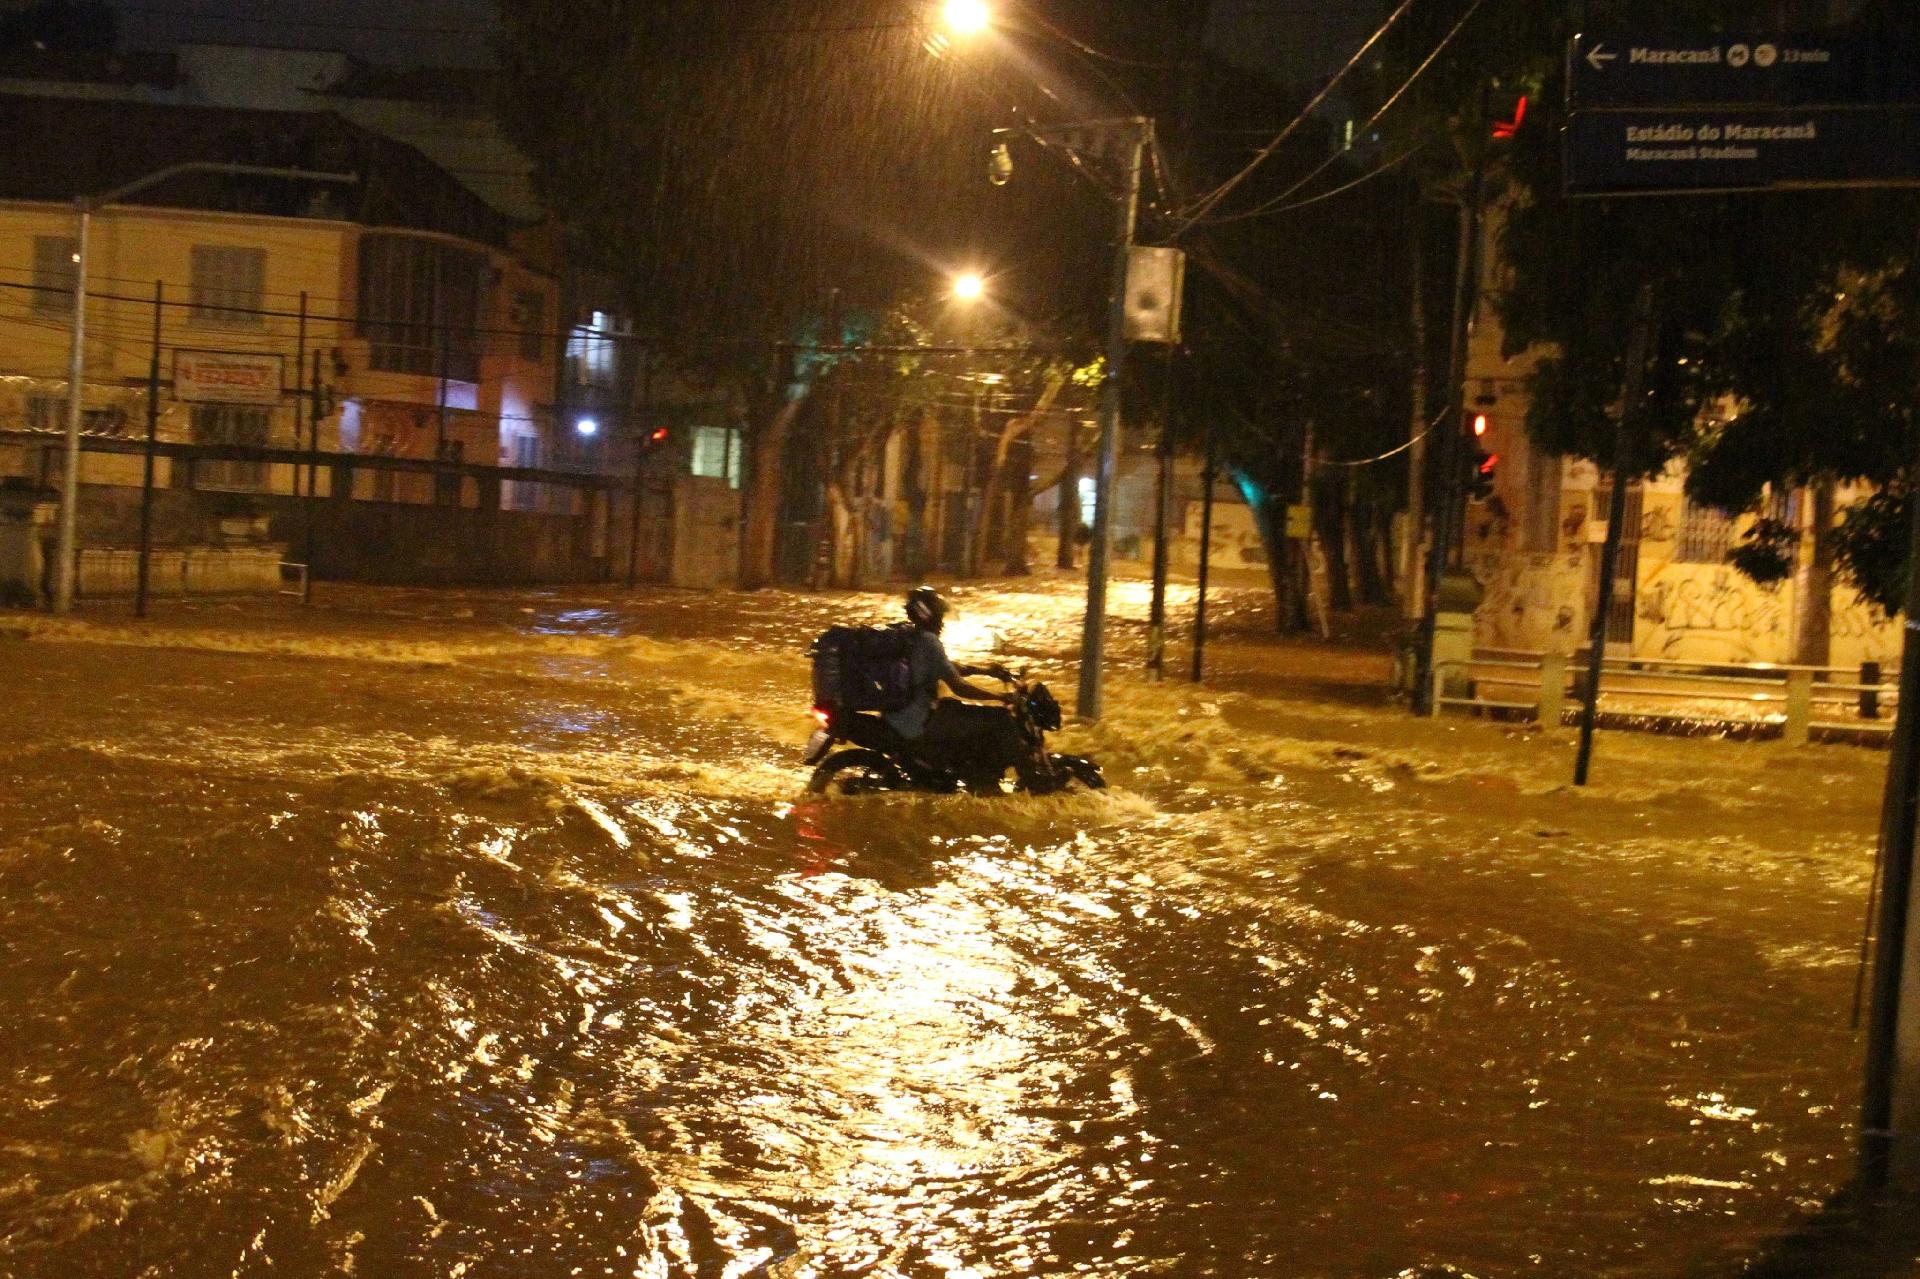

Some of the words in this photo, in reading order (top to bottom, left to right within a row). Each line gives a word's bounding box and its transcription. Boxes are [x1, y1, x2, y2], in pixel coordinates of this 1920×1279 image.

[1626, 124, 1694, 142] Estádio
[1697, 124, 1720, 141] do
[1724, 121, 1816, 140] Maracanã
